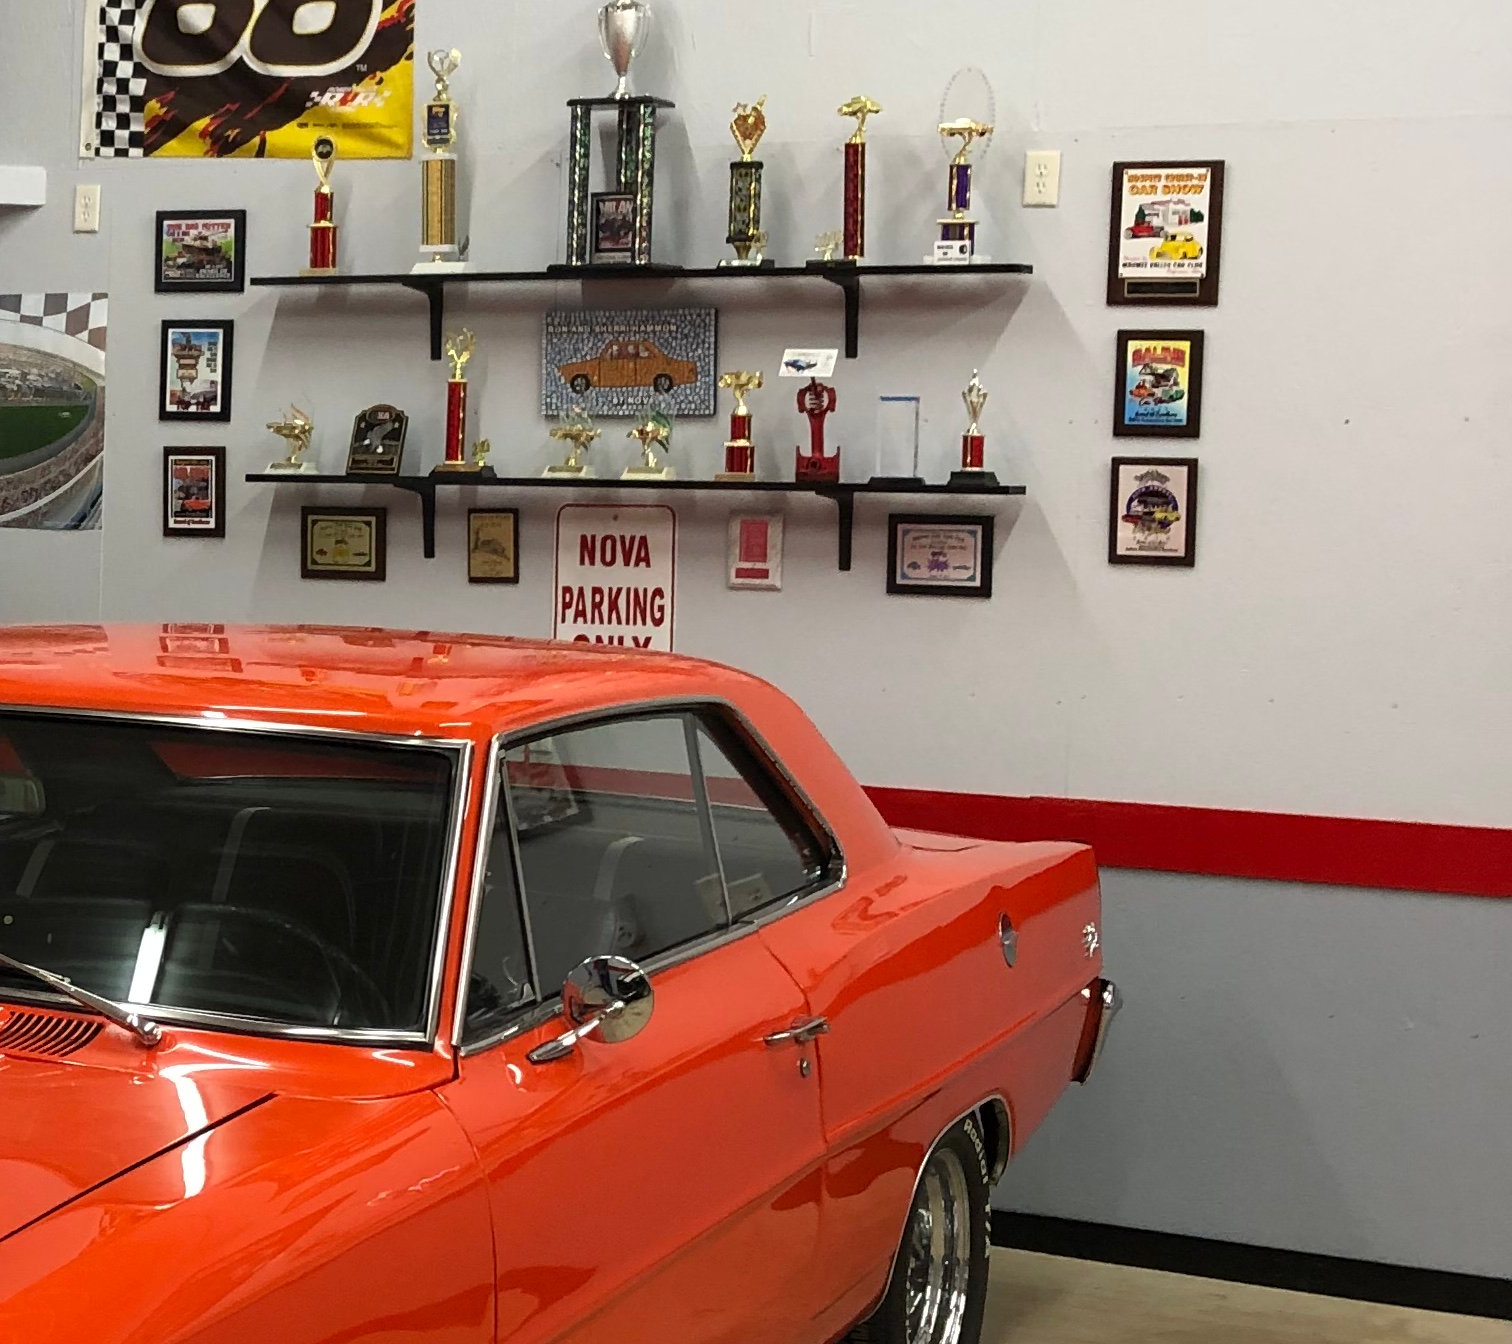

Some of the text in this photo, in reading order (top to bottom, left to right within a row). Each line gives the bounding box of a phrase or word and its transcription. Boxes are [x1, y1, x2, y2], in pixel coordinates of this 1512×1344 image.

[1128, 184, 1158, 196] CAR
[578, 533, 652, 568] NOVA
[560, 585, 665, 628] PARKING
